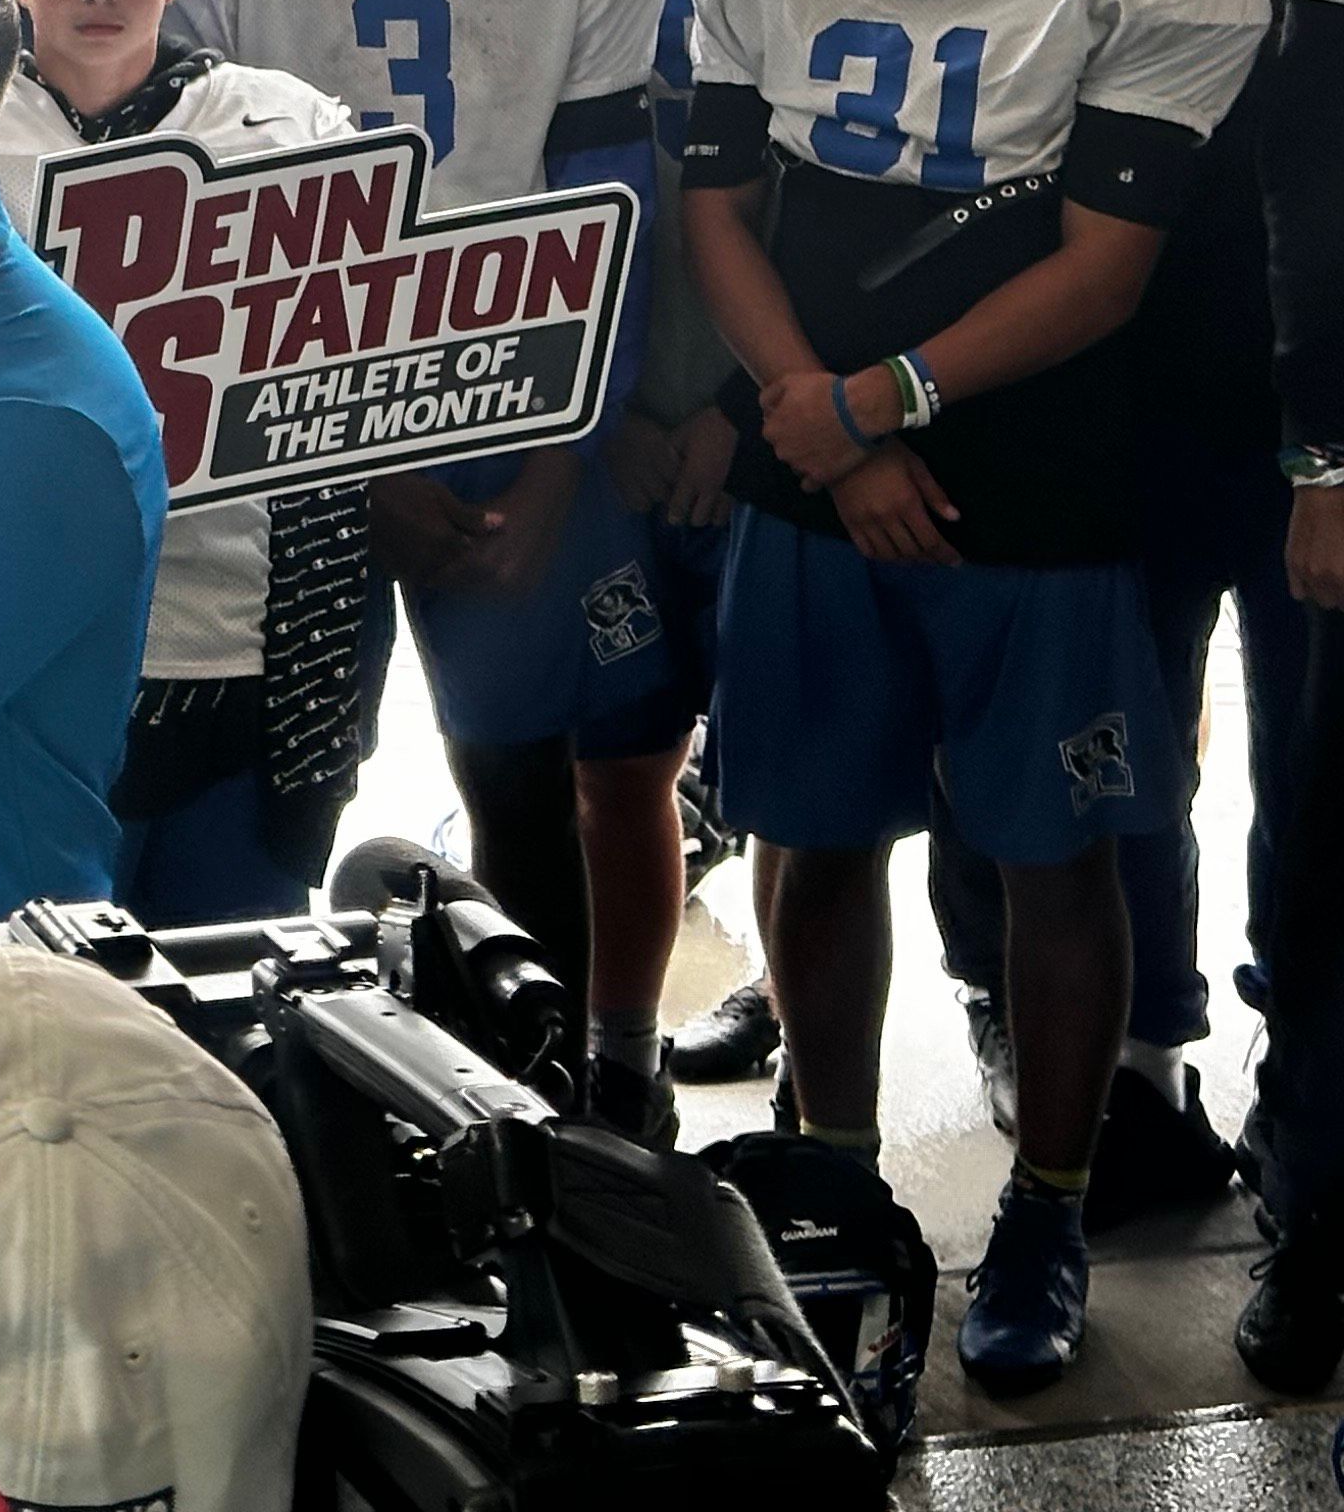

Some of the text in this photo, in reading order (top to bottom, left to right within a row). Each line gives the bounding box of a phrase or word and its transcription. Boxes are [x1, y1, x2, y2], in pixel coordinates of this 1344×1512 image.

[809, 18, 988, 187] 31
[59, 160, 399, 330] PENN
[122, 220, 607, 489] STATION
[246, 336, 520, 423] ATHLETE OF
[264, 378, 534, 463] THE MONTH
